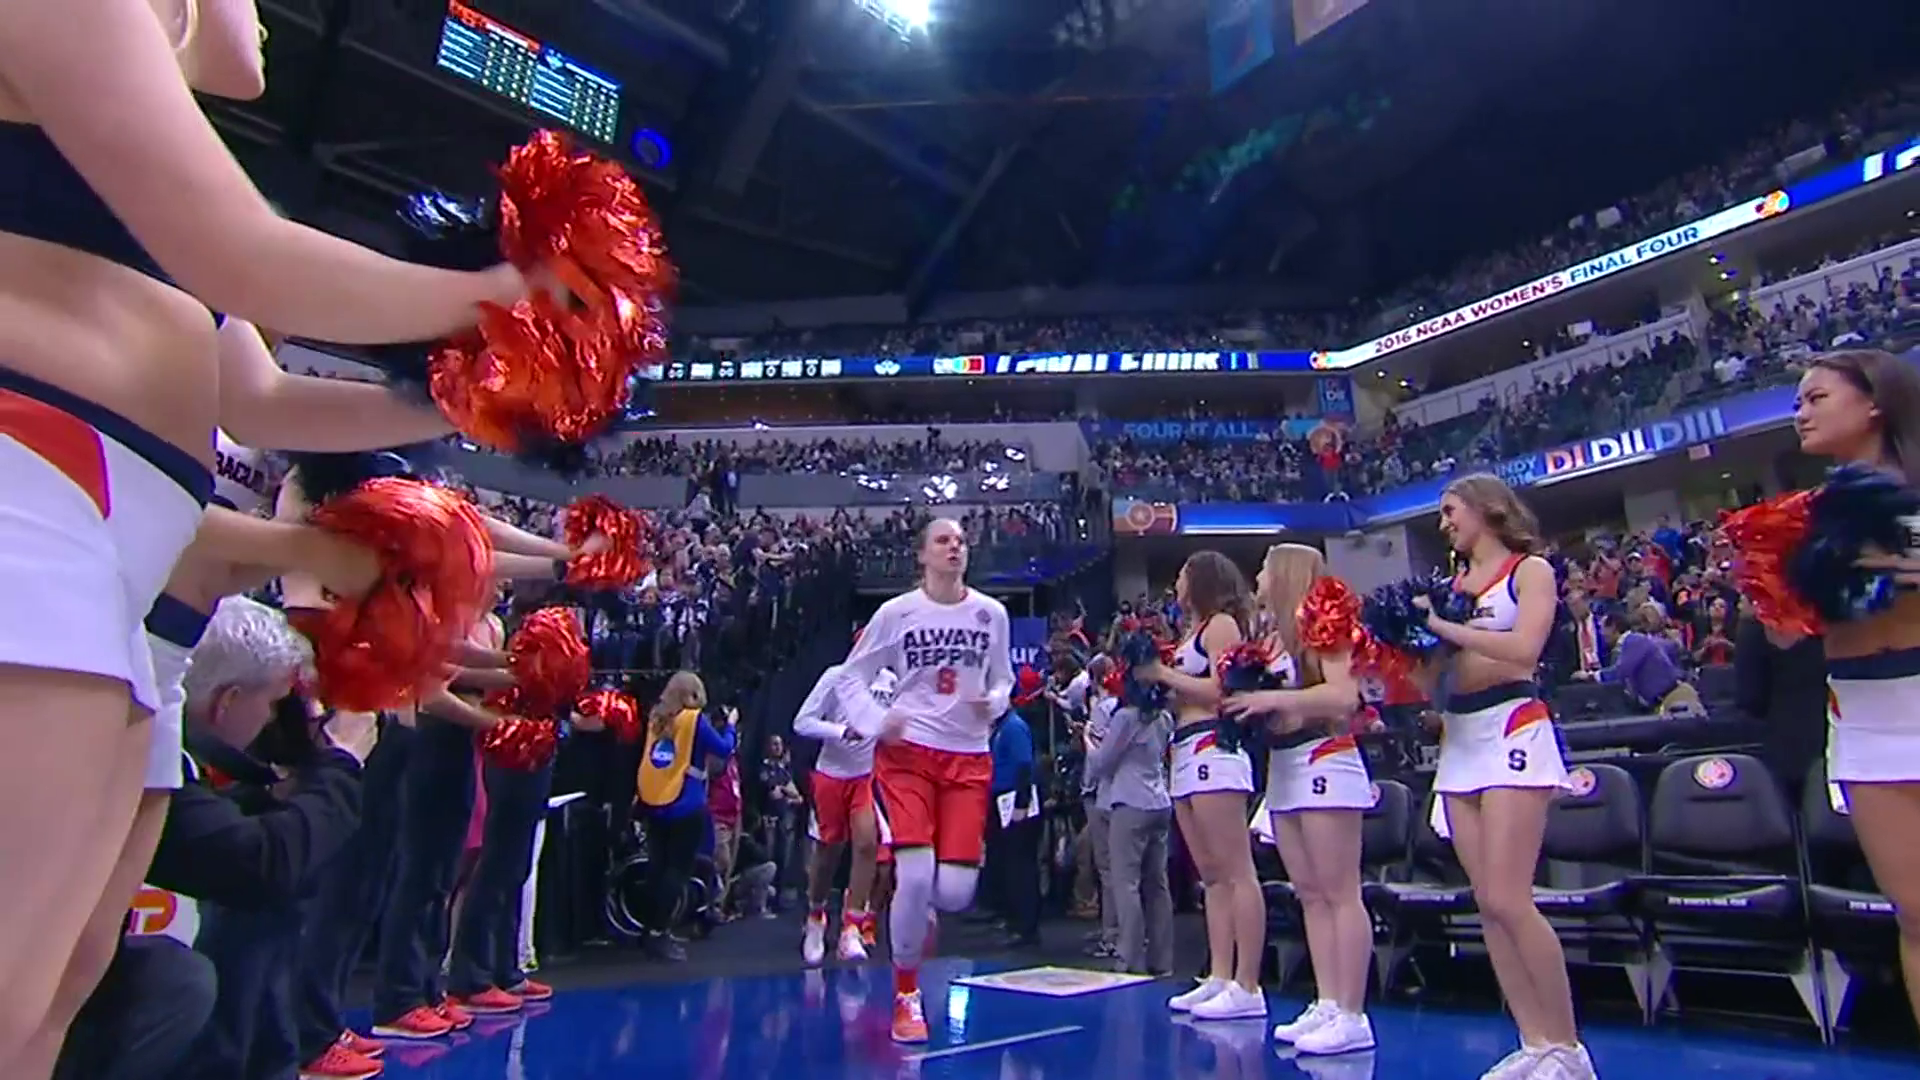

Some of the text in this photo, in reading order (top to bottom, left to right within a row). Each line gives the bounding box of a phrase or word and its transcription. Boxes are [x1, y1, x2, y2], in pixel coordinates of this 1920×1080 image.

[1374, 226, 1699, 353] 2016 NCAA WOMEN'S FINAL FOUR
[1123, 421, 1182, 439] FOUR
[1545, 407, 1725, 475] DI DII DIII
[903, 628, 990, 651] ALWAYS
[1508, 749, 1527, 771] S
[1198, 764, 1209, 781] S
[1312, 776, 1327, 795] S
